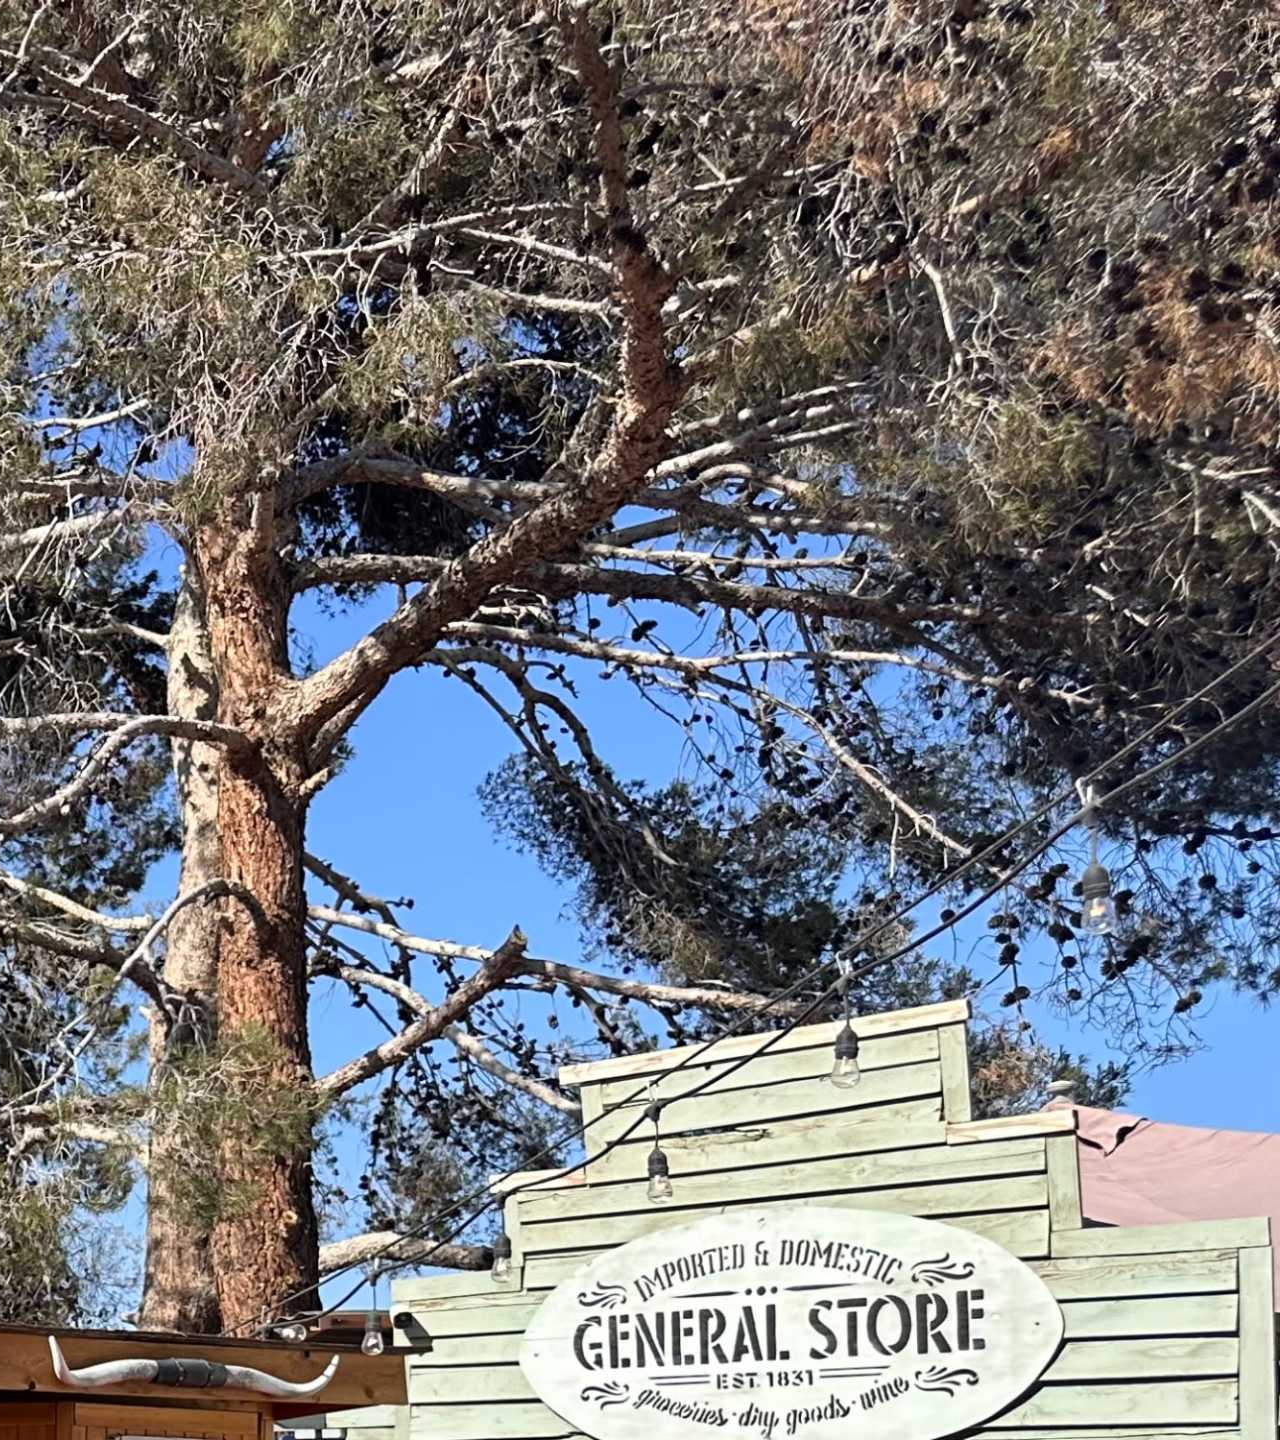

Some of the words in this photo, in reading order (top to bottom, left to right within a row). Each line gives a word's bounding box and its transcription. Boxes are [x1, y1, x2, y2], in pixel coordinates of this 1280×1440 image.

[633, 1243, 746, 1302] IMPORTED
[755, 1241, 769, 1267] &
[778, 1239, 903, 1285] DOMESTIC
[573, 1304, 790, 1370] GENERAL
[808, 1288, 986, 1361] STORE
[633, 1388, 728, 1426] groceries
[739, 1402, 779, 1437] dry
[786, 1394, 850, 1435] goods
[859, 1376, 910, 1411] wine
[716, 1372, 761, 1390] EST.
[767, 1369, 815, 1387] 1831
